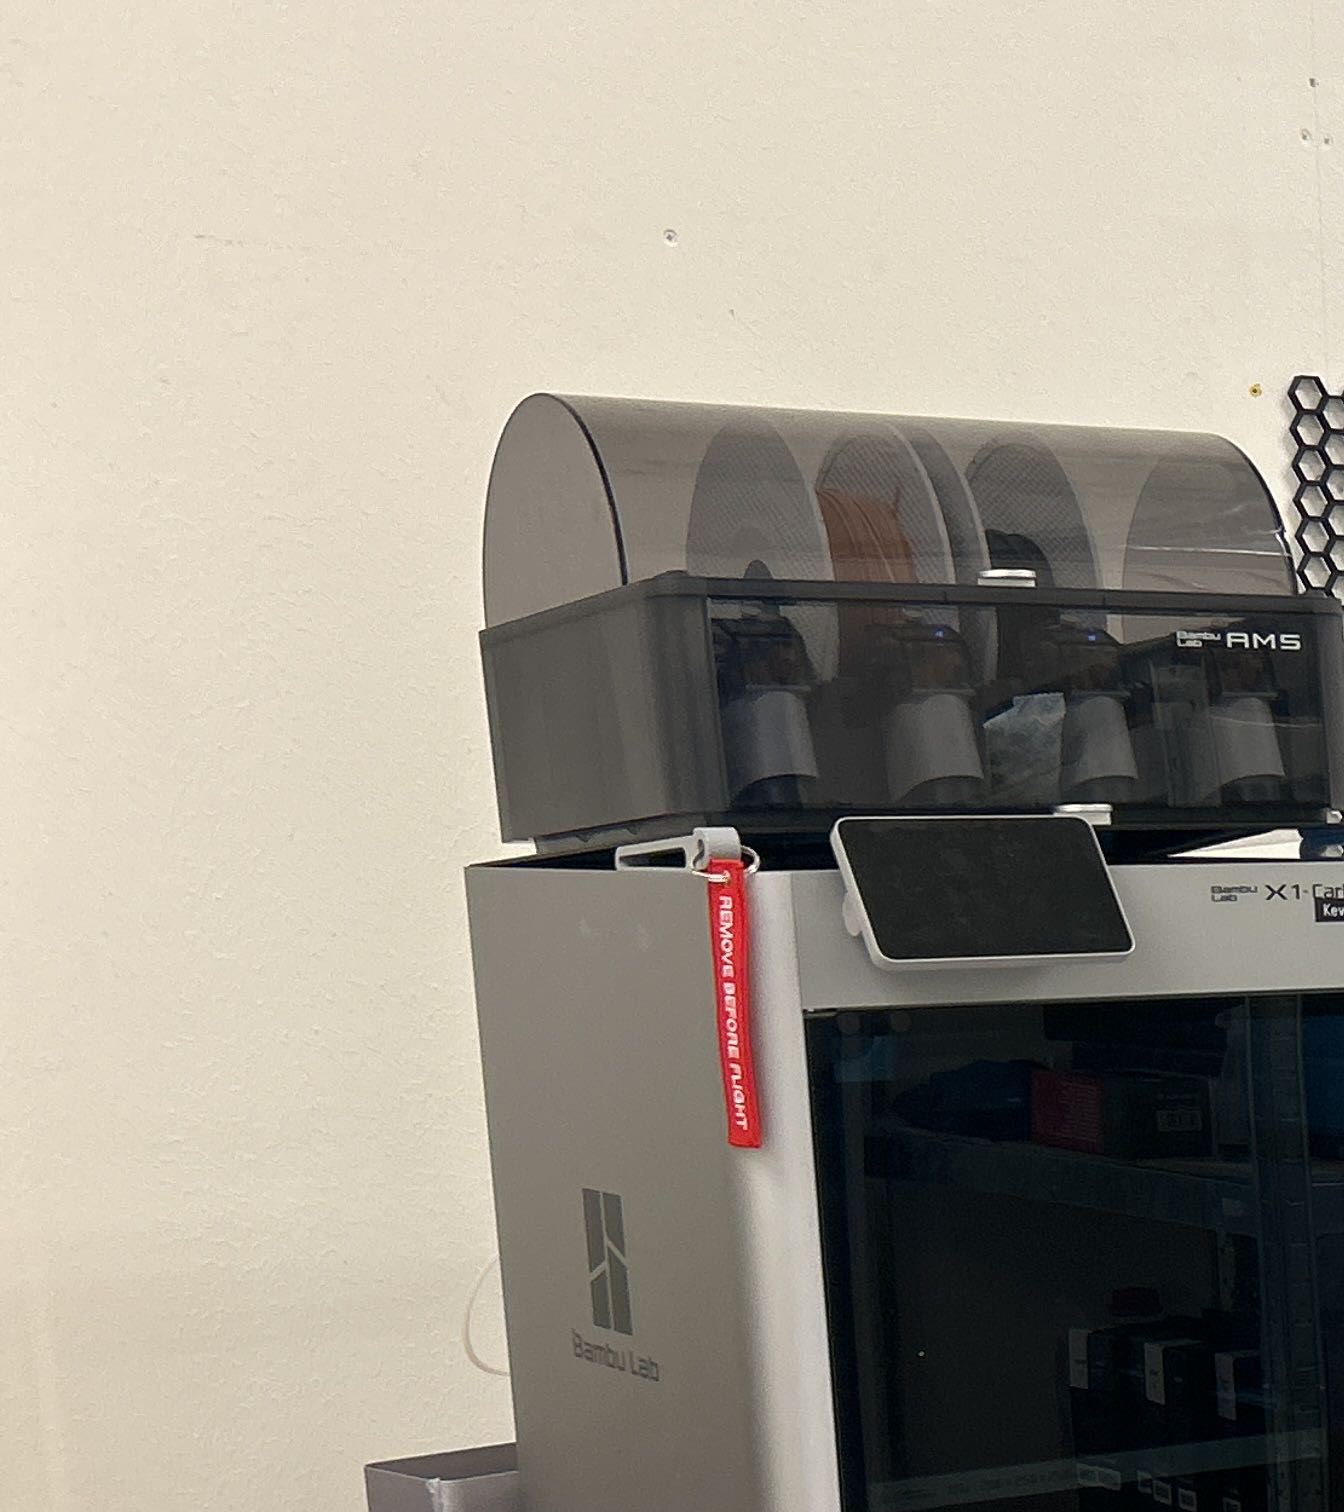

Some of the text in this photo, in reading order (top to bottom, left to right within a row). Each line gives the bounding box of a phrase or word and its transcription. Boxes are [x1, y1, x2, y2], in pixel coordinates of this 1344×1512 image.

[1226, 632, 1301, 650] AMS
[718, 895, 748, 1131] REMOVE BEFORE FLIGHT
[571, 1328, 660, 1382] Bambu Lab
